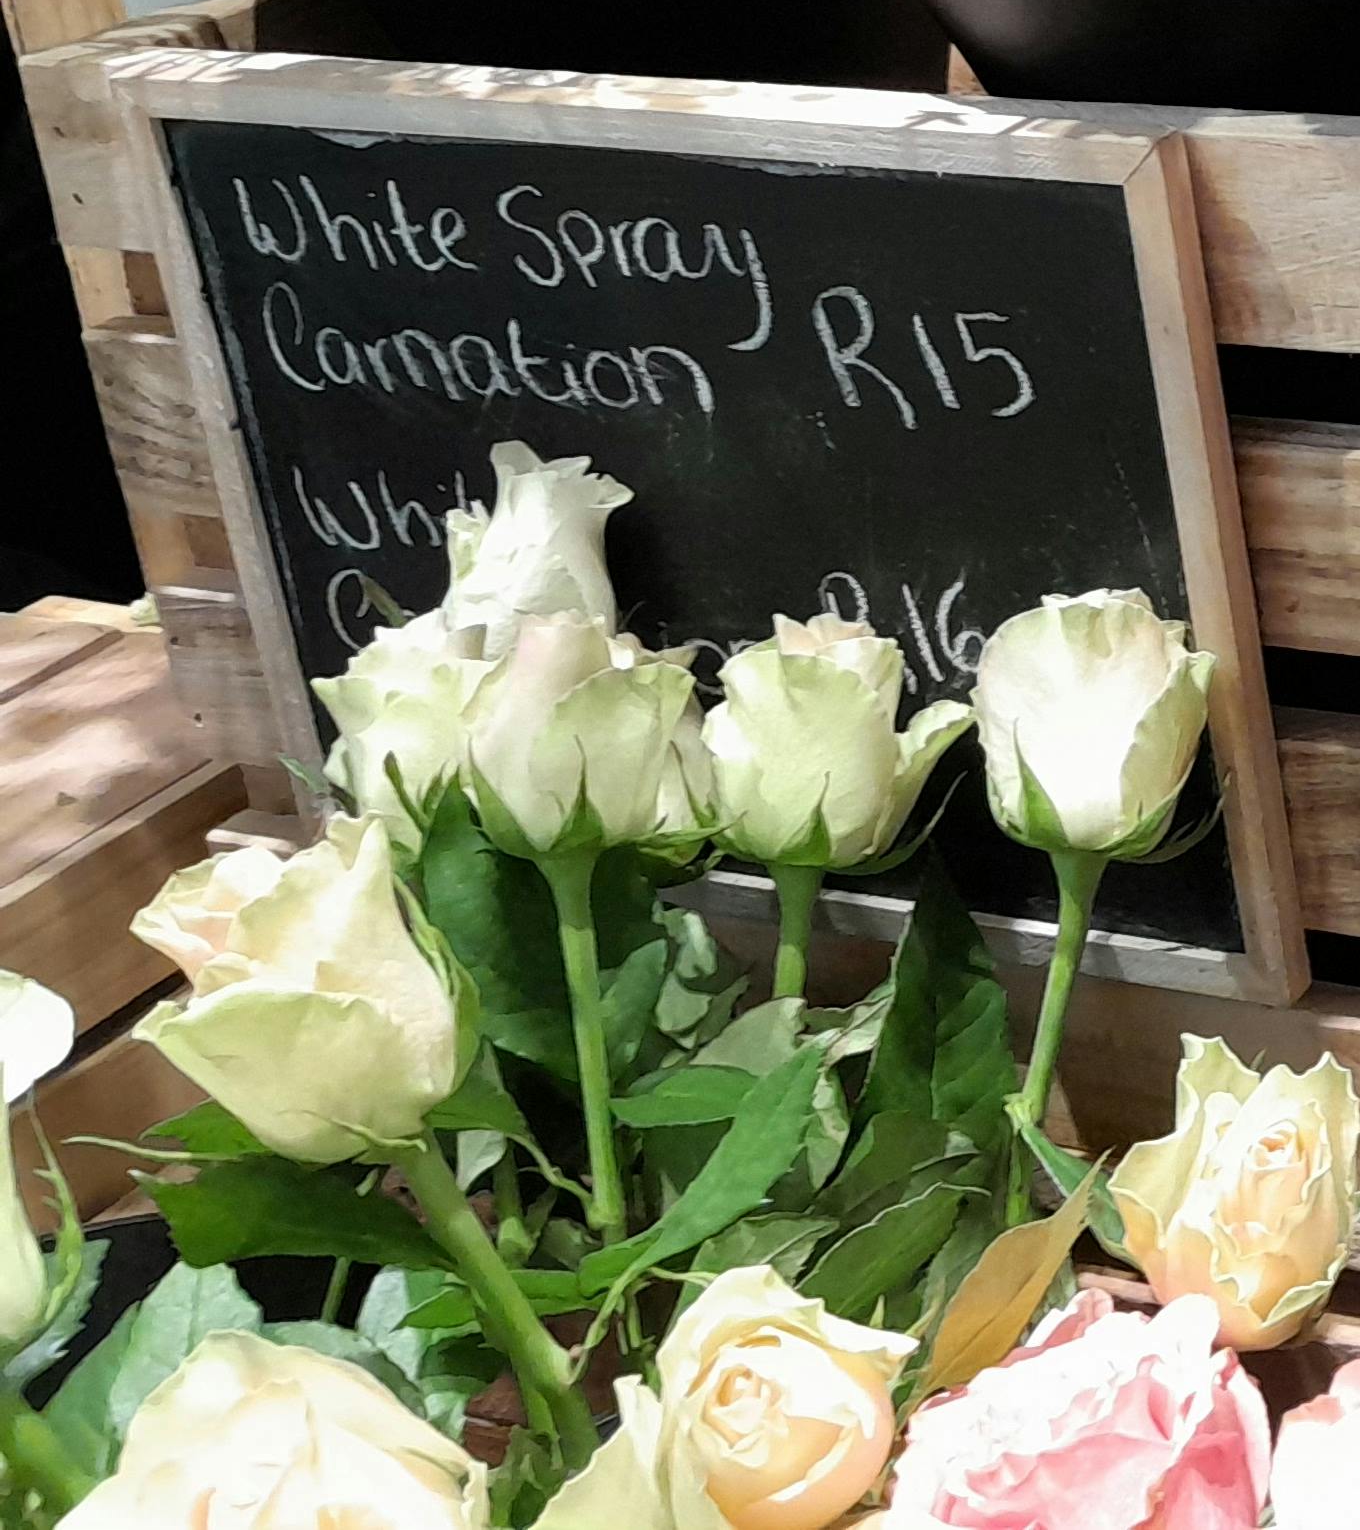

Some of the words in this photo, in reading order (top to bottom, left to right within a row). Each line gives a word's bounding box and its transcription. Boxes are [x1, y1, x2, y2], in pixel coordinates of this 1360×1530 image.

[232, 174, 479, 271] White
[498, 184, 774, 352] Spray
[262, 281, 716, 414] Carnation
[811, 285, 1038, 430] R15
